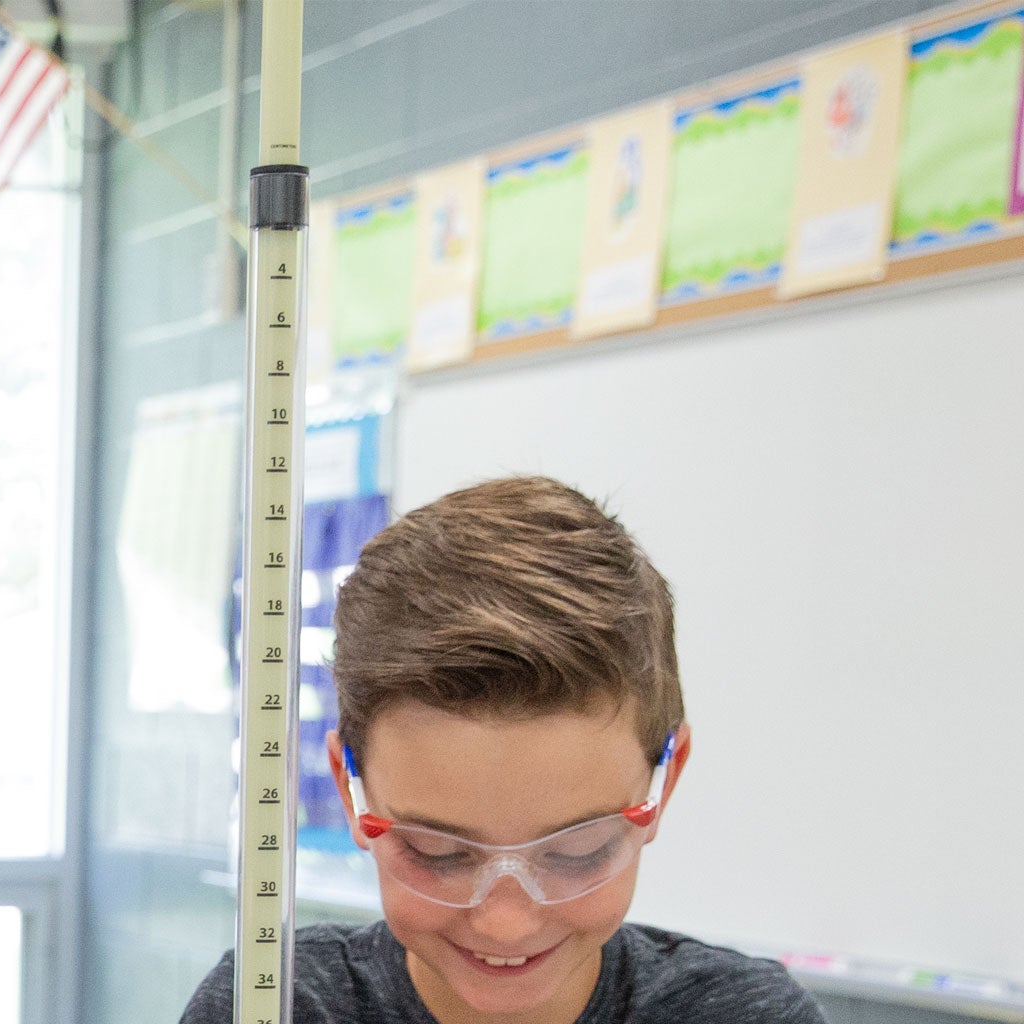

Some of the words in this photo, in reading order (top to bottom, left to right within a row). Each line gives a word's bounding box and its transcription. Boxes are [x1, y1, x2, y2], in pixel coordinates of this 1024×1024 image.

[278, 263, 287, 274] 4
[277, 312, 286, 323] 6
[276, 360, 285, 371] 8
[272, 408, 287, 419] 10
[270, 456, 285, 467] 12
[270, 504, 285, 515] 14
[269, 552, 284, 563] 16
[267, 599, 282, 610] 18
[265, 647, 282, 658] 20
[264, 694, 281, 705] 22
[263, 741, 279, 752] 24
[262, 788, 278, 799] 26
[261, 834, 277, 845] 28
[260, 881, 276, 892] 30
[259, 927, 275, 938] 32
[258, 973, 274, 984] 34
